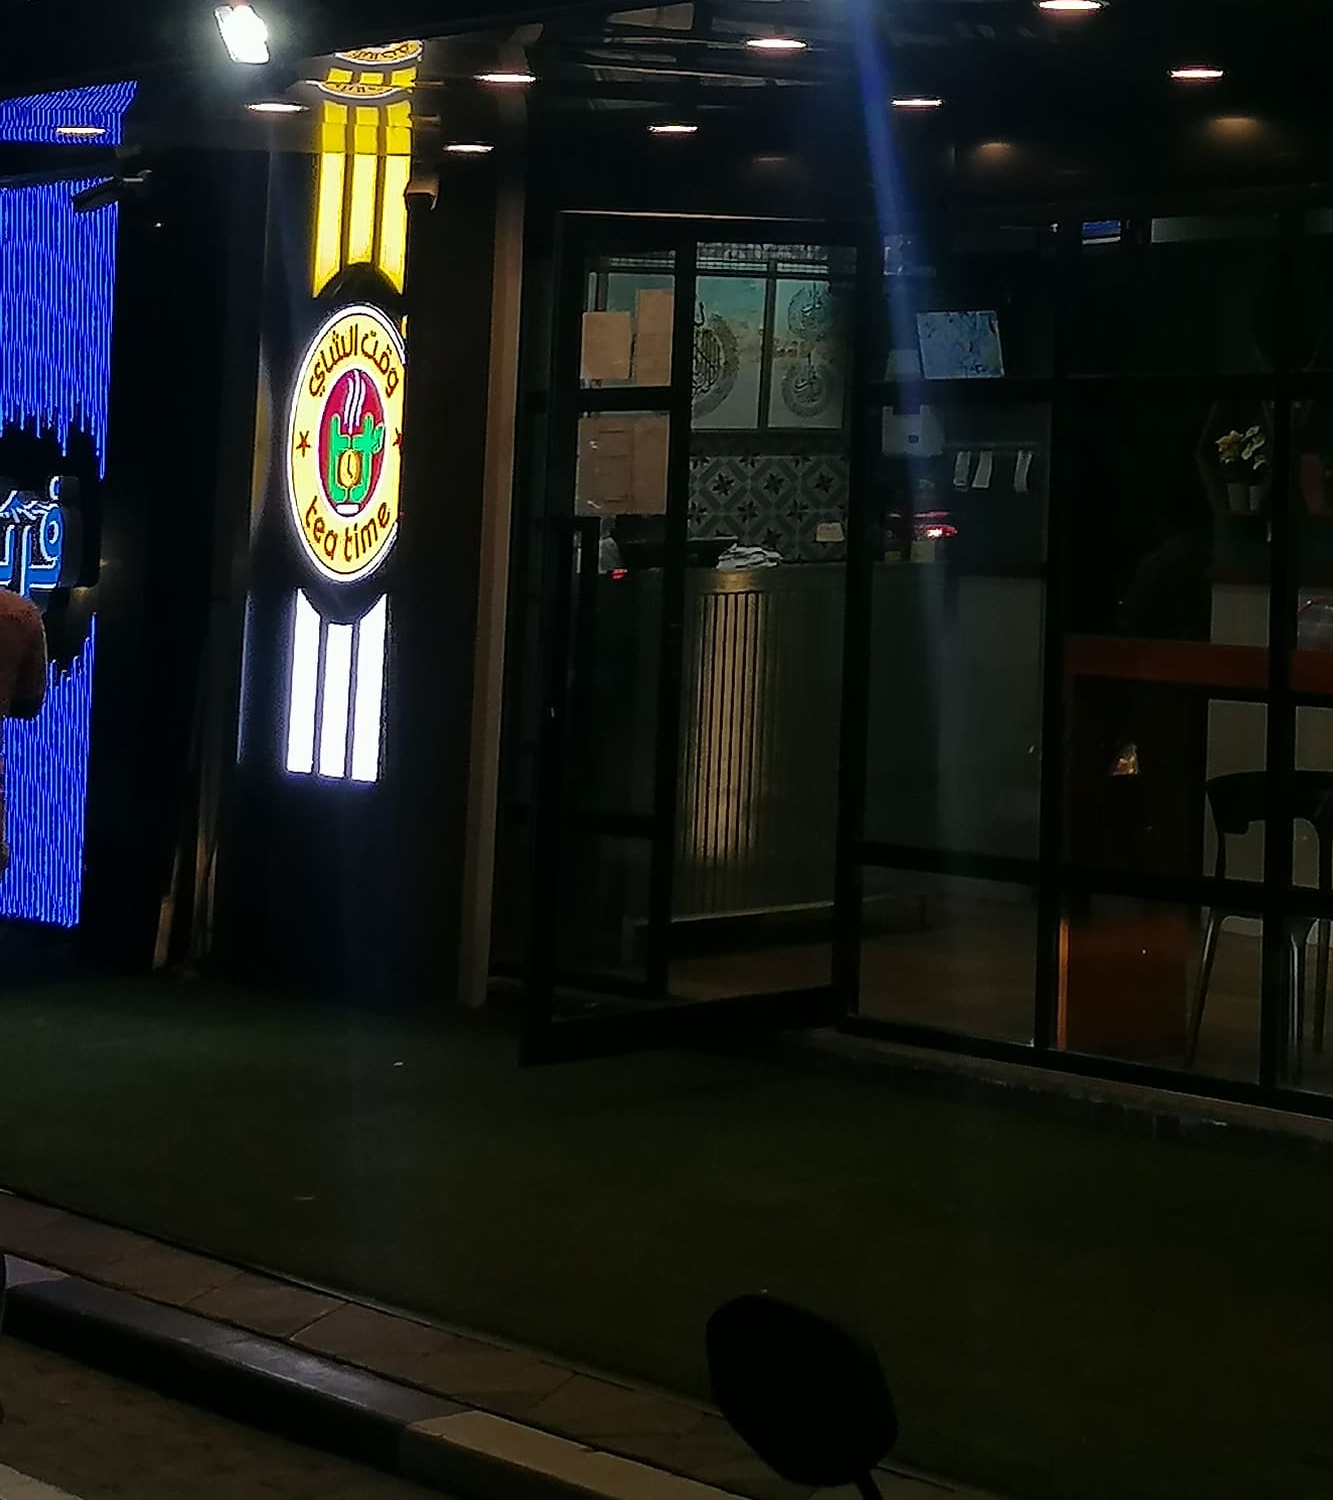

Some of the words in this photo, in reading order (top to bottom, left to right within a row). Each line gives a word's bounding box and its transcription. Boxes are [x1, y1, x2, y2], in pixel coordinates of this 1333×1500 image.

[308, 323, 359, 398] الشاي
[360, 330, 399, 398] وقت
[305, 494, 337, 561] tea
[344, 500, 391, 563] time
